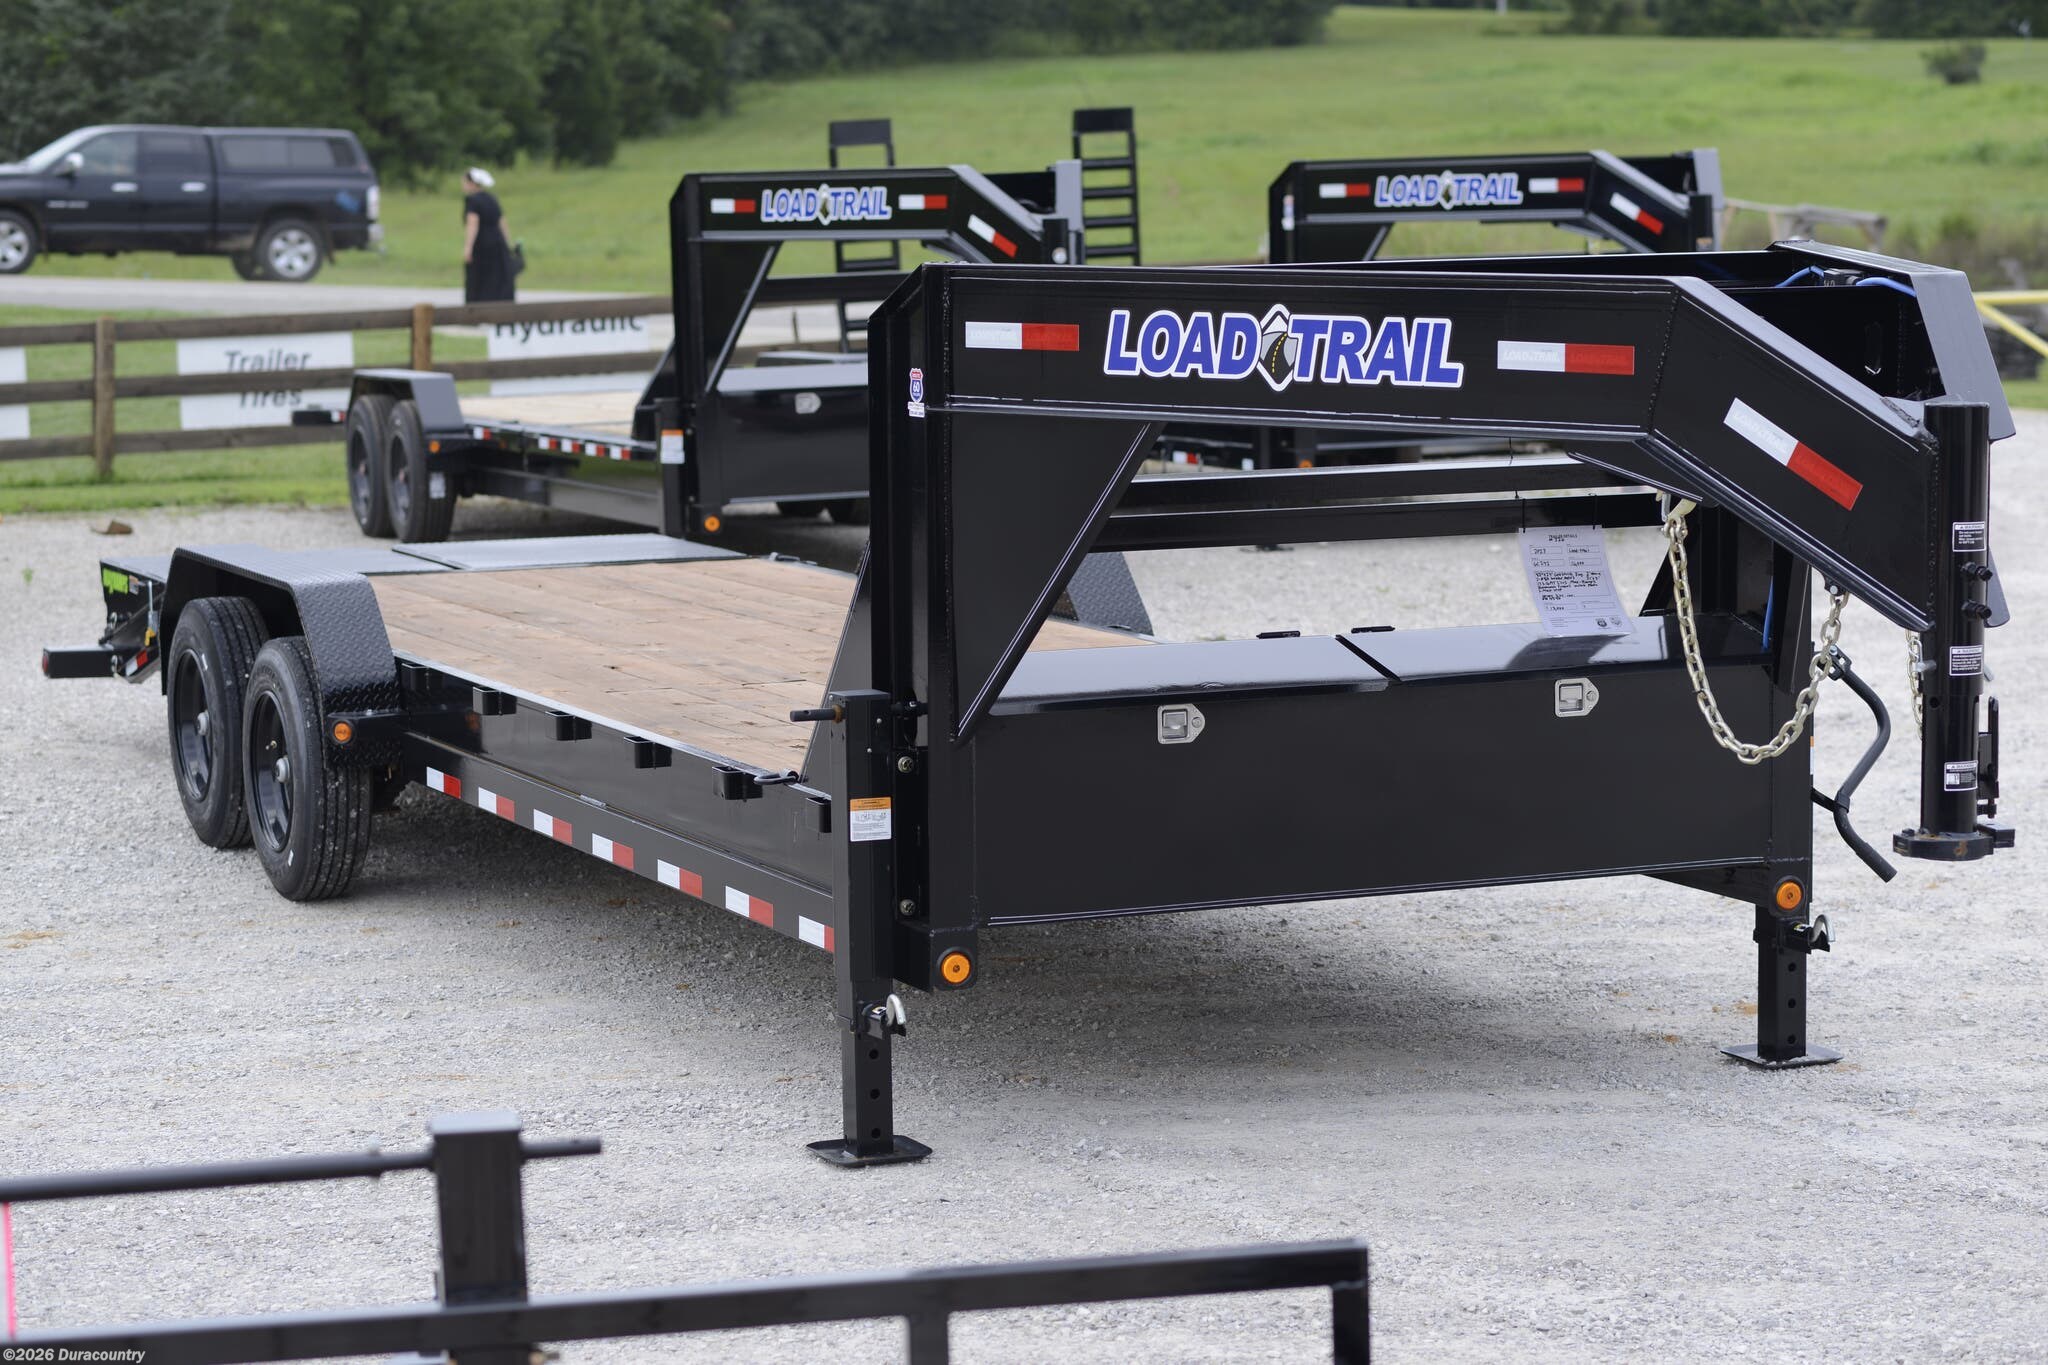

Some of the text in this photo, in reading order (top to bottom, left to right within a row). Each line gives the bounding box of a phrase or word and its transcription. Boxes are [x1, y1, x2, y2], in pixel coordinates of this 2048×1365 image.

[760, 186, 892, 222] LOAD TRAIL
[1374, 172, 1524, 208] LOAD TRAIL
[225, 348, 312, 372] Trailer
[1104, 310, 1465, 388] LOAD TRAIL
